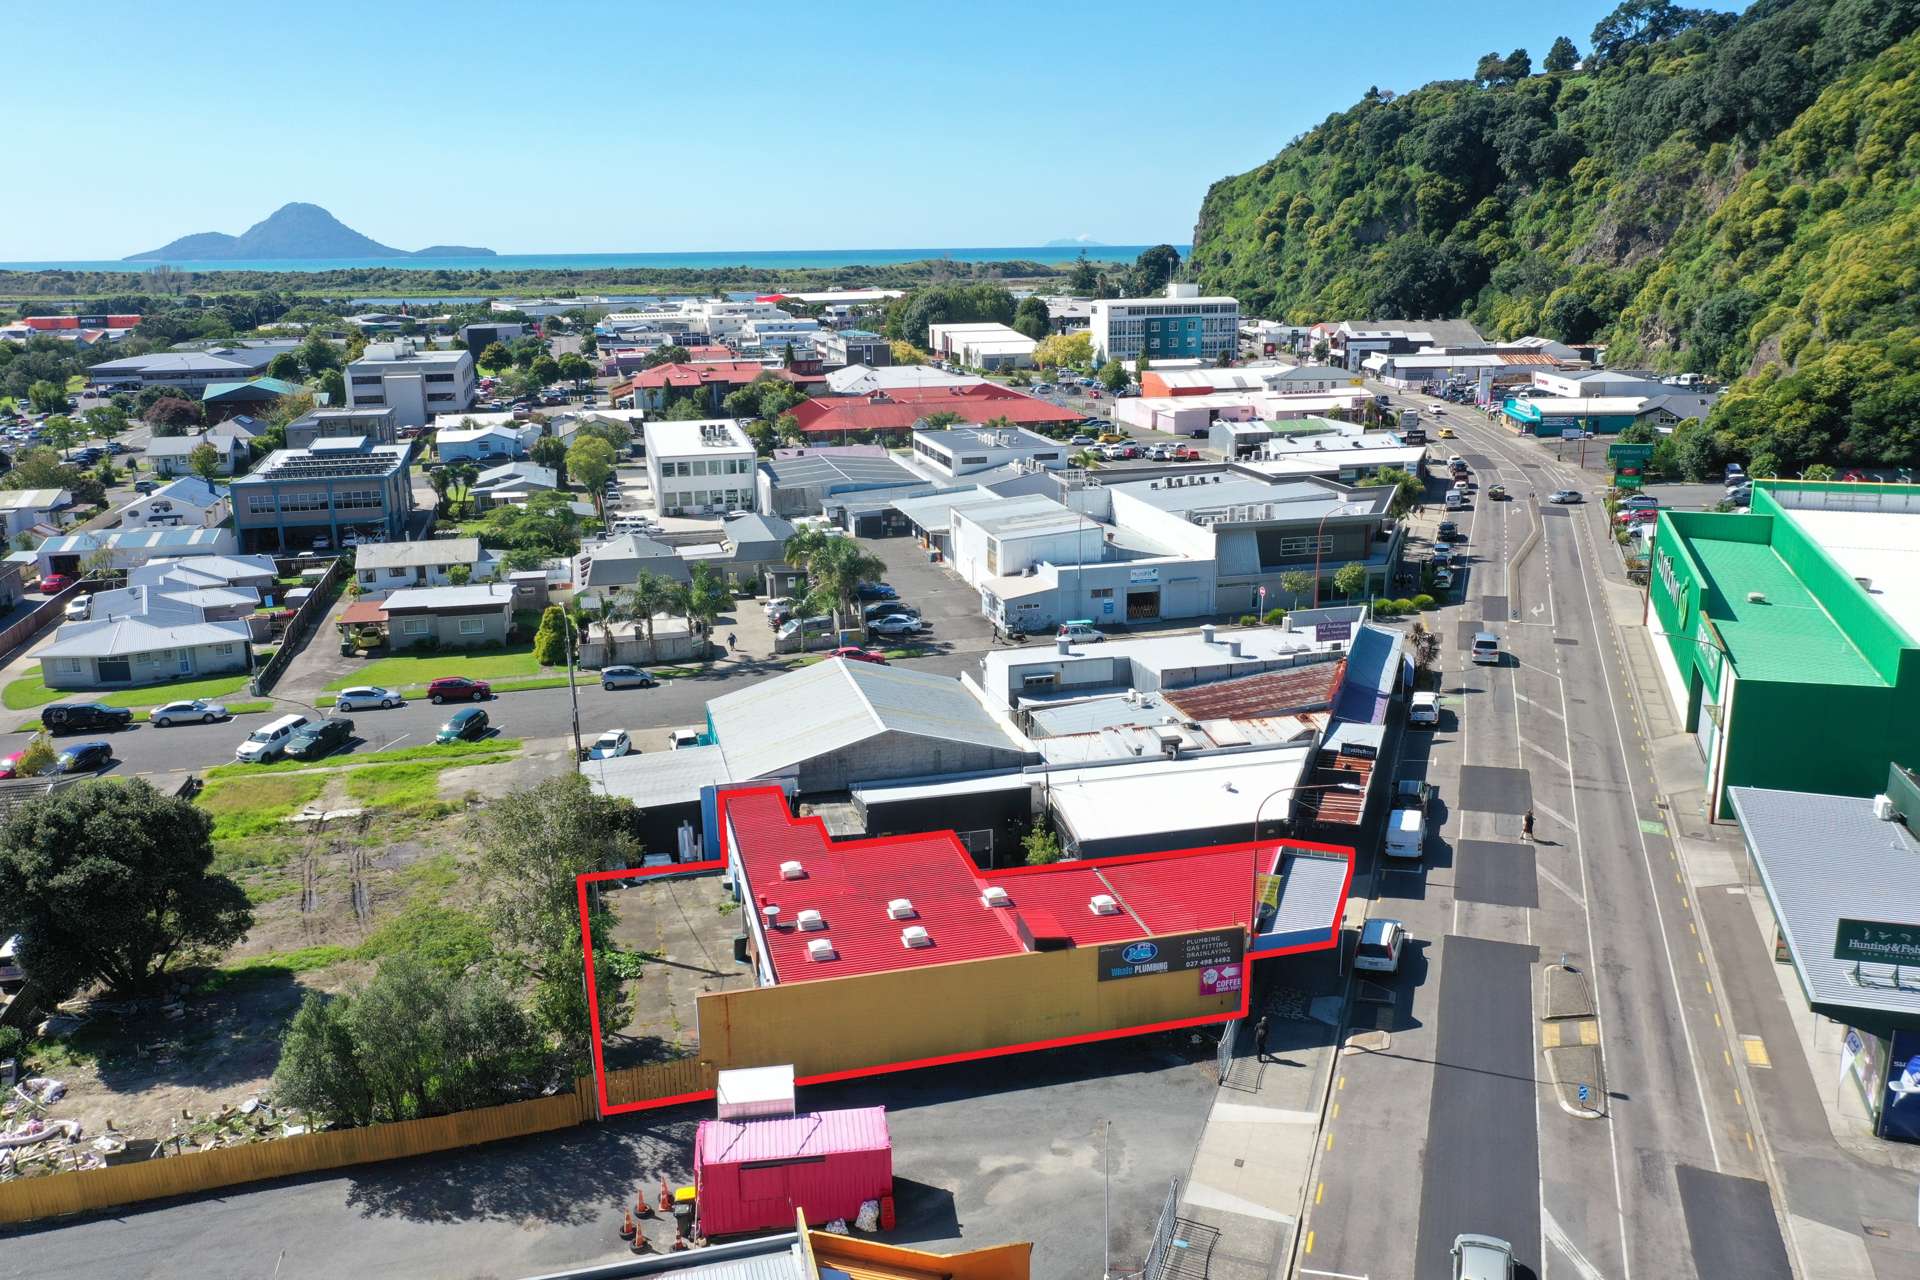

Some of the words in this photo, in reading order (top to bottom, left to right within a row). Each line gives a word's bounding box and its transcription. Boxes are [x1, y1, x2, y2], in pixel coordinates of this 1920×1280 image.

[1187, 936, 1221, 945] PLUMBING
[1186, 943, 1201, 952] GAS
[1202, 940, 1229, 950] FITTING
[1187, 948, 1231, 958] DRAINLAYING
[1134, 961, 1168, 975] PLUMBING
[1185, 959, 1199, 968] 027
